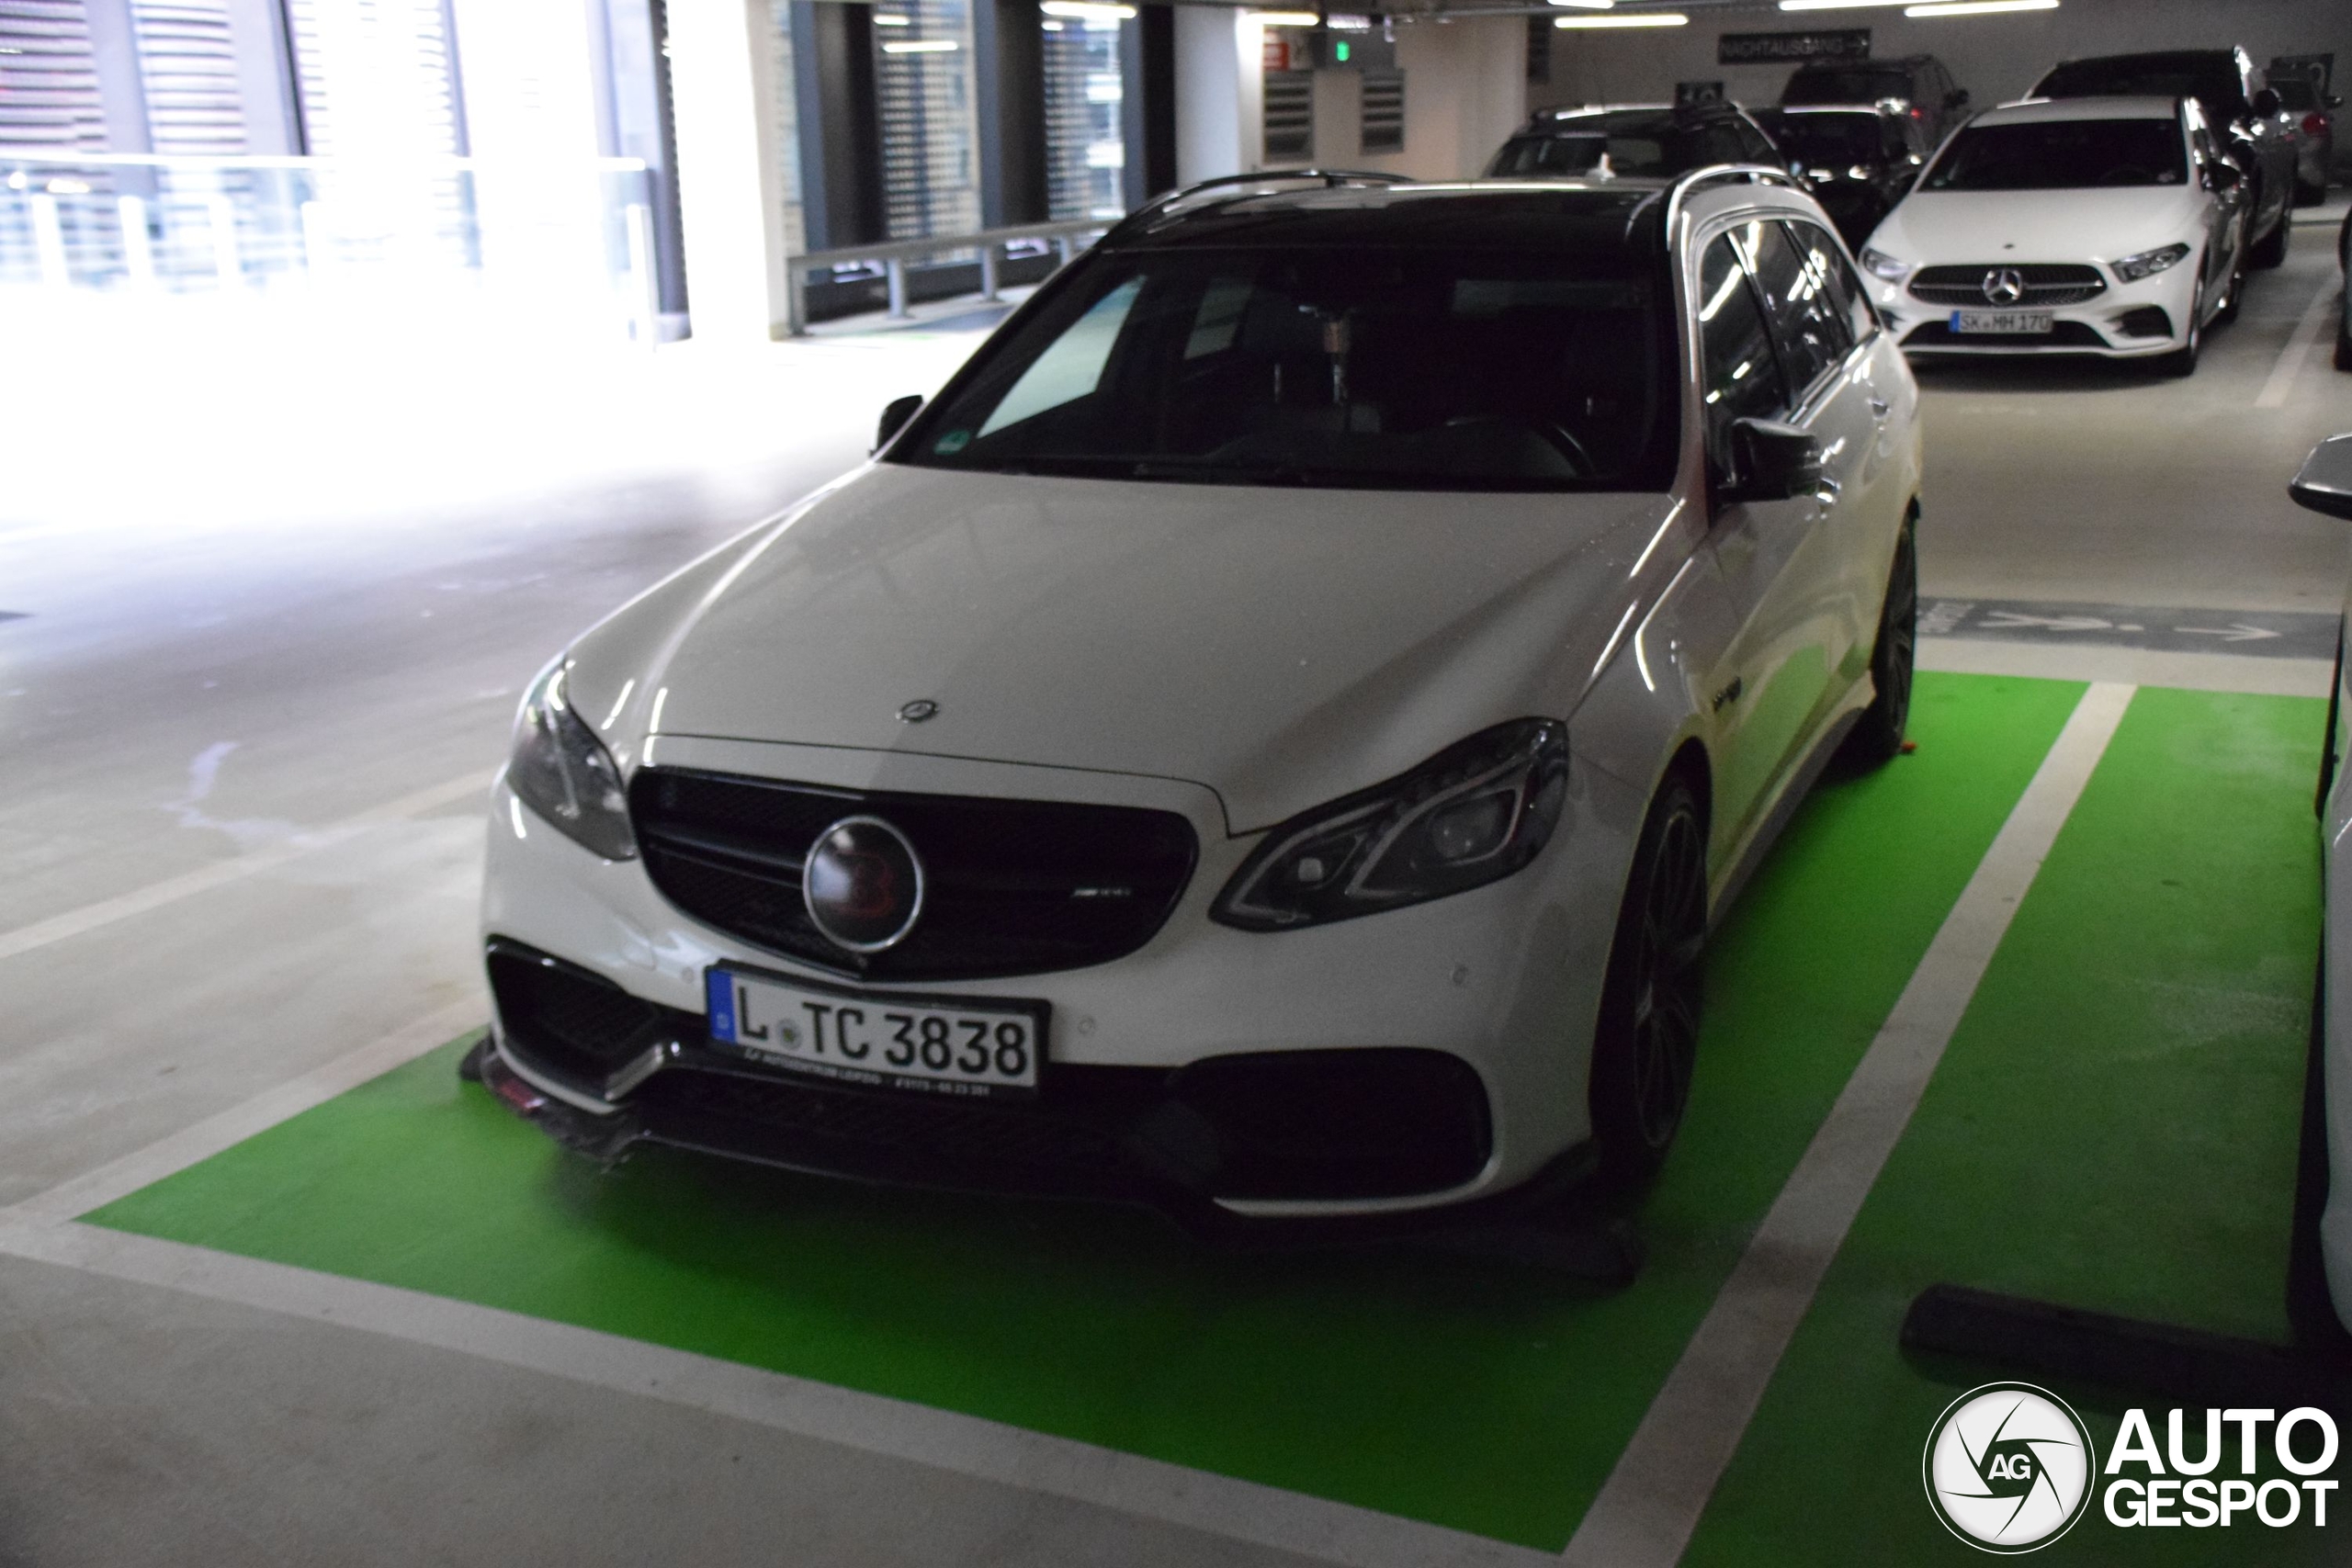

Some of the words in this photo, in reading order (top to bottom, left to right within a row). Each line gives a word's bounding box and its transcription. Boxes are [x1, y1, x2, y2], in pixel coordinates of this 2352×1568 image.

[2018, 314, 2052, 330] 170
[739, 986, 768, 1040] L
[801, 1000, 869, 1060] TC
[884, 1013, 1026, 1076] 3838
